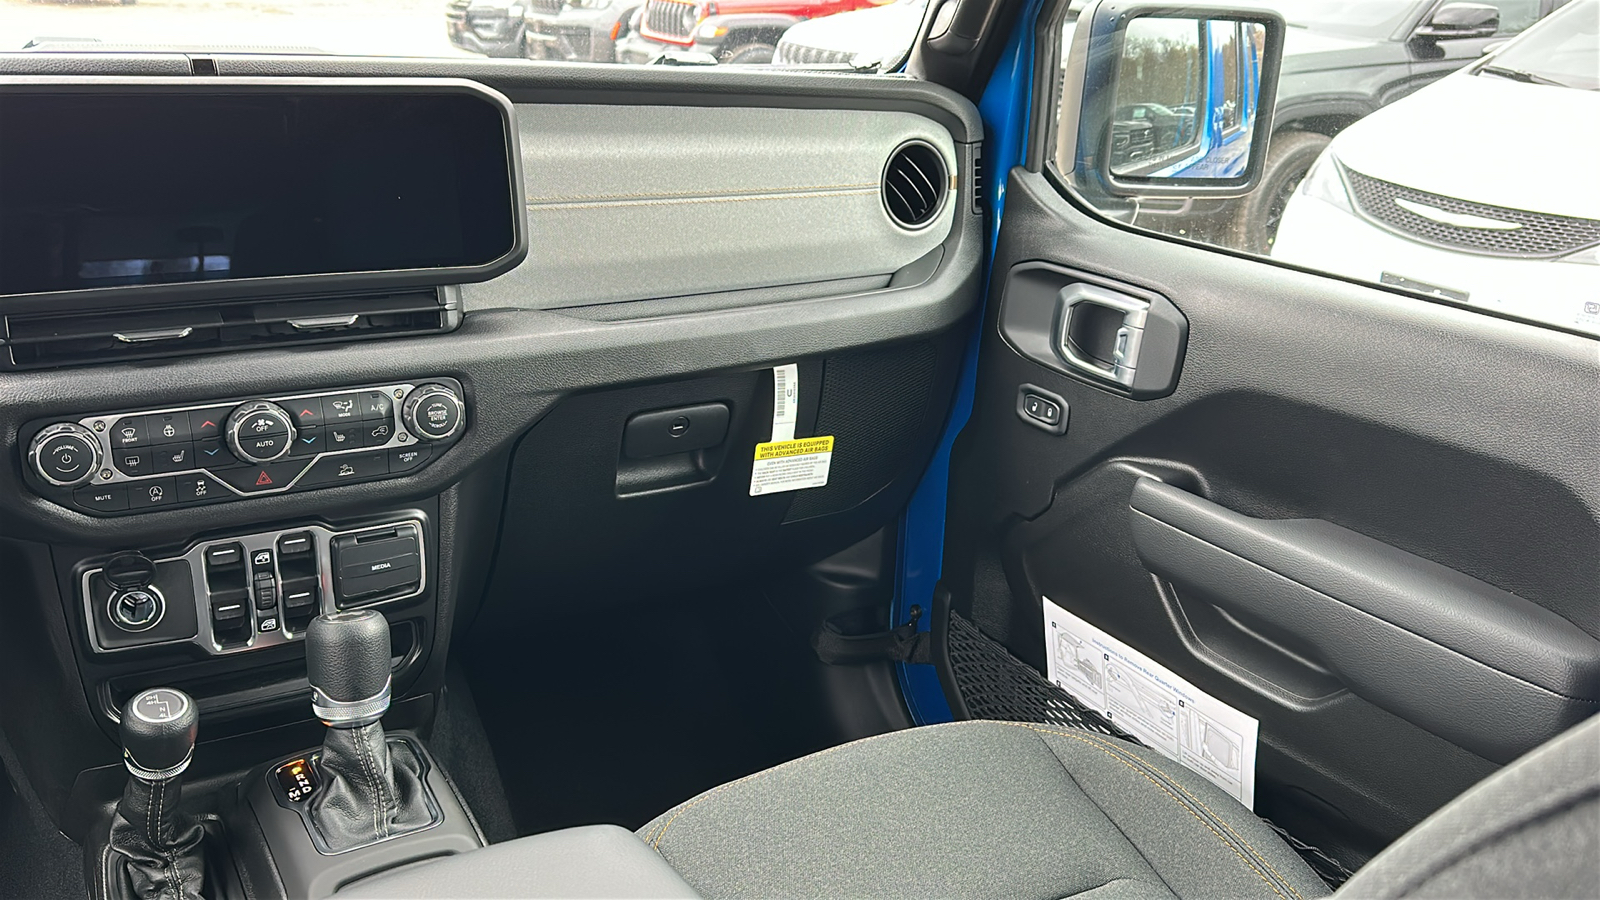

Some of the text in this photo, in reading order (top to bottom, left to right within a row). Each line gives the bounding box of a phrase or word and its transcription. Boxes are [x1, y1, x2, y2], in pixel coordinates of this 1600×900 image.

[371, 403, 384, 411] A/C
[256, 424, 269, 432] OFF
[55, 444, 75, 452] VOLUME
[256, 440, 274, 448] AUTO
[773, 443, 796, 451] VEHICLE
[803, 440, 830, 448] EQUIPPED
[399, 451, 418, 459] SCREEN
[775, 448, 804, 457] ADVANCED
[371, 562, 391, 572] MEDIA
[1124, 656, 1143, 672] Remove
[1142, 667, 1154, 678] Rear
[1154, 675, 1173, 689] Quarter
[295, 773, 306, 781] R
[298, 779, 310, 787] N
[302, 786, 312, 794] D
